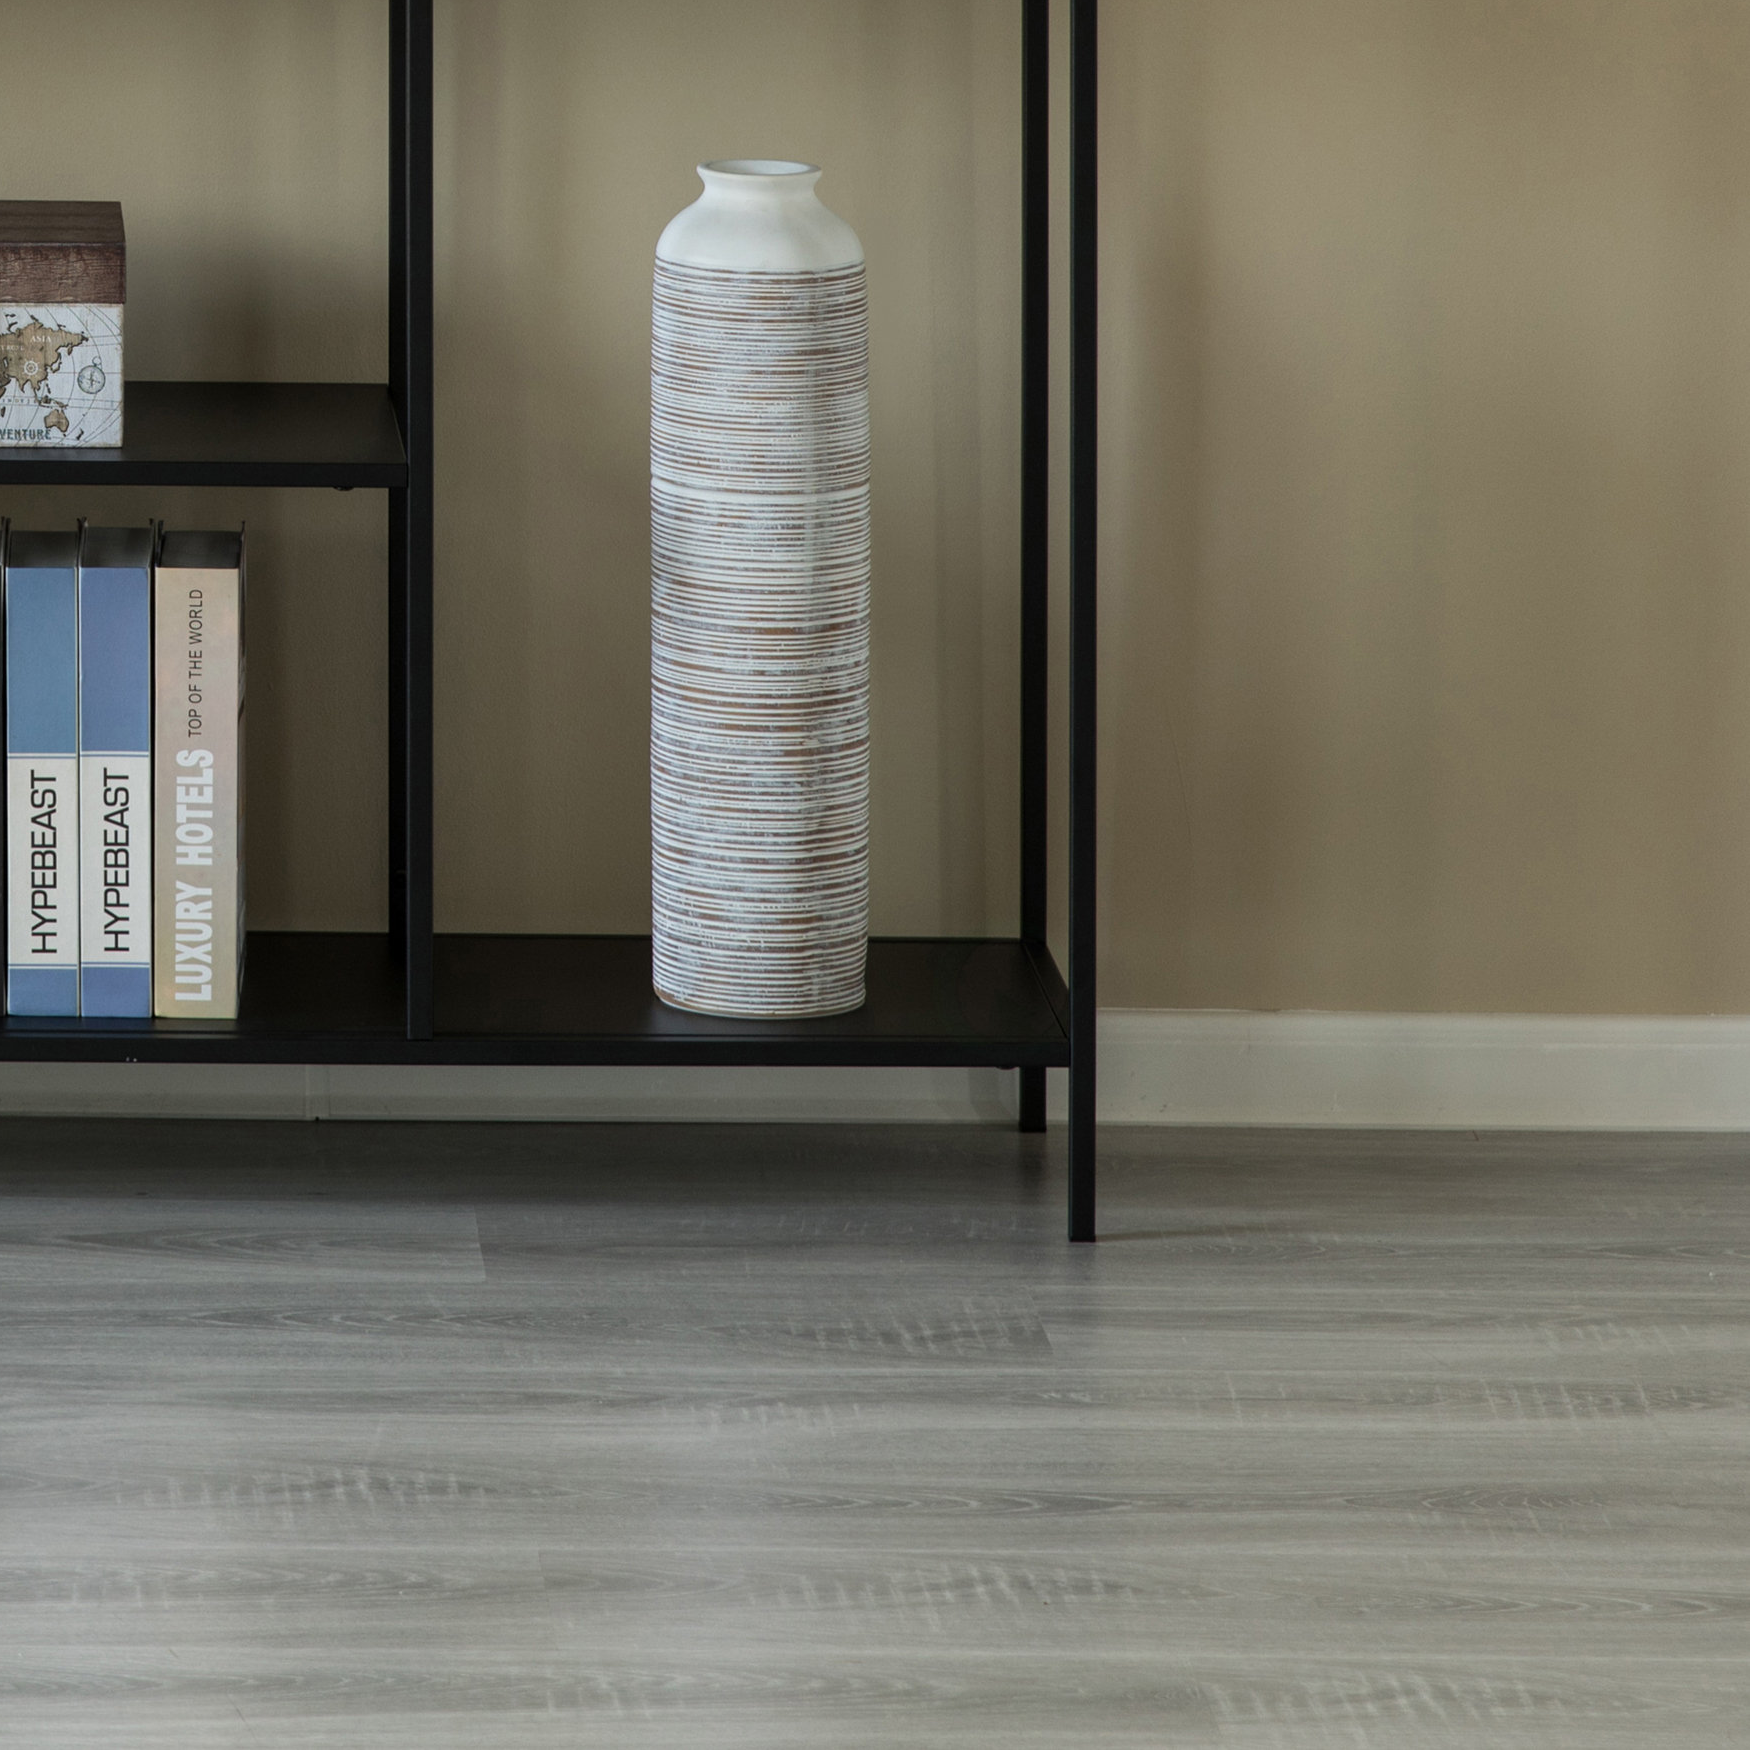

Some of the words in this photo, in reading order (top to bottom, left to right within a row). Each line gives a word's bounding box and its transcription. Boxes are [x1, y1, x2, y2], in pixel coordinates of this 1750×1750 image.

[188, 588, 203, 644] WORLD
[188, 650, 203, 679] THE
[188, 683, 203, 704] OF
[188, 708, 203, 738] TOP
[175, 749, 214, 865] HOTELS
[30, 768, 57, 954] HYPEBEAST
[103, 767, 130, 952] HYPEBEAST
[175, 881, 213, 1002] LUXURY
